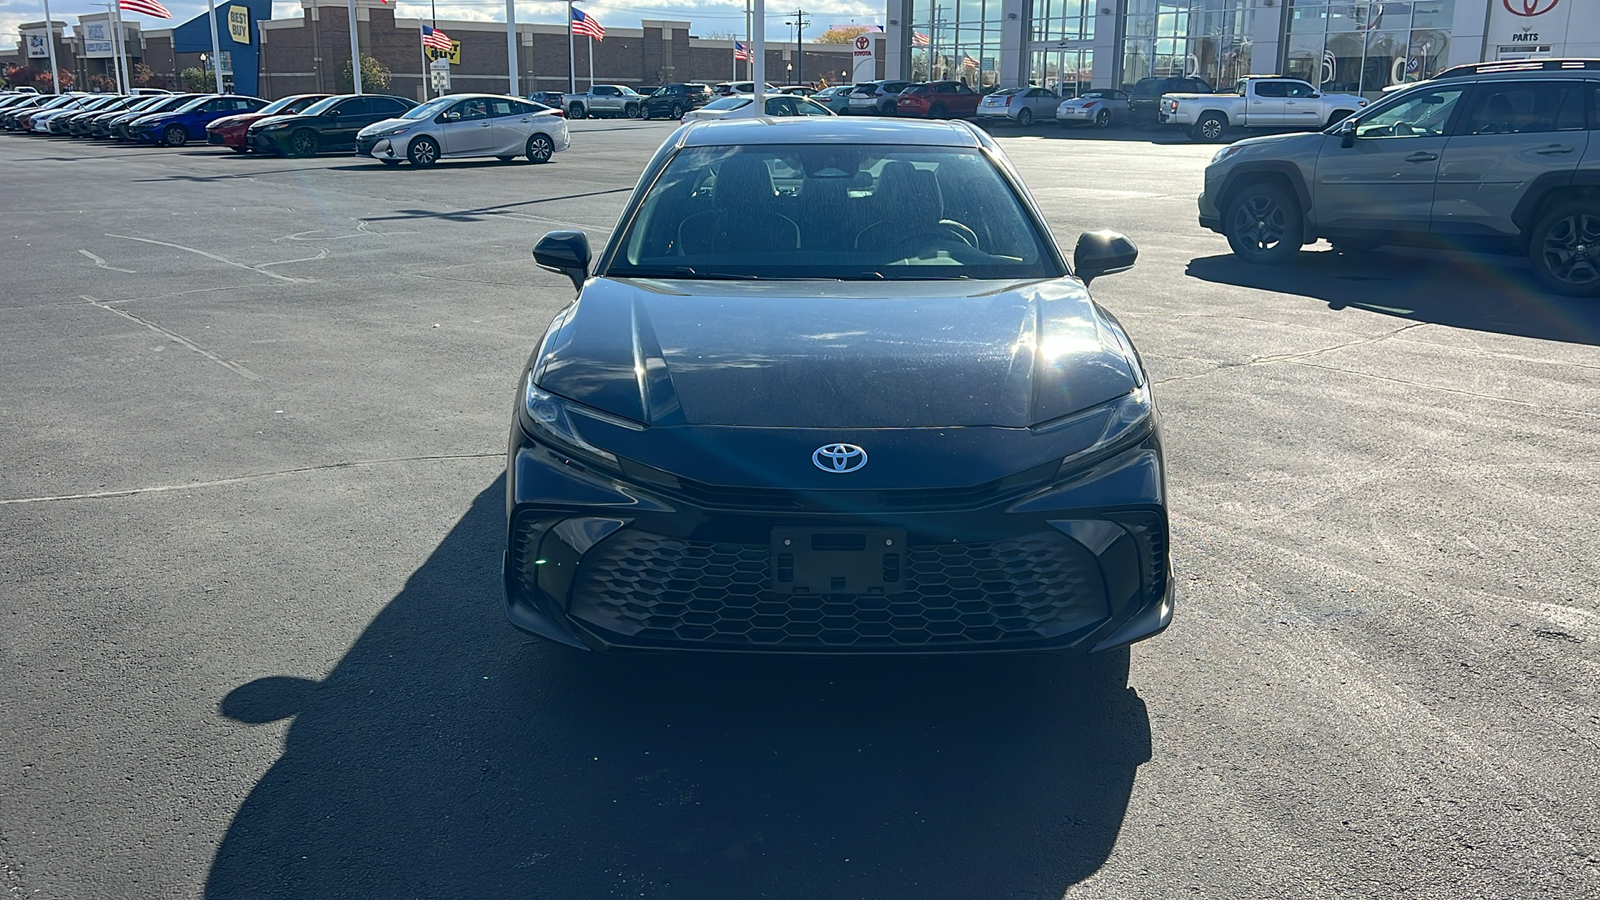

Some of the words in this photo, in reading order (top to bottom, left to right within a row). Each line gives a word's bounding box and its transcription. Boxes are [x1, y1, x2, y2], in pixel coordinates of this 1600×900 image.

[230, 11, 247, 25] BEST
[232, 24, 247, 37] BUY
[1512, 33, 1539, 42] PARTS
[431, 49, 456, 60] BUY
